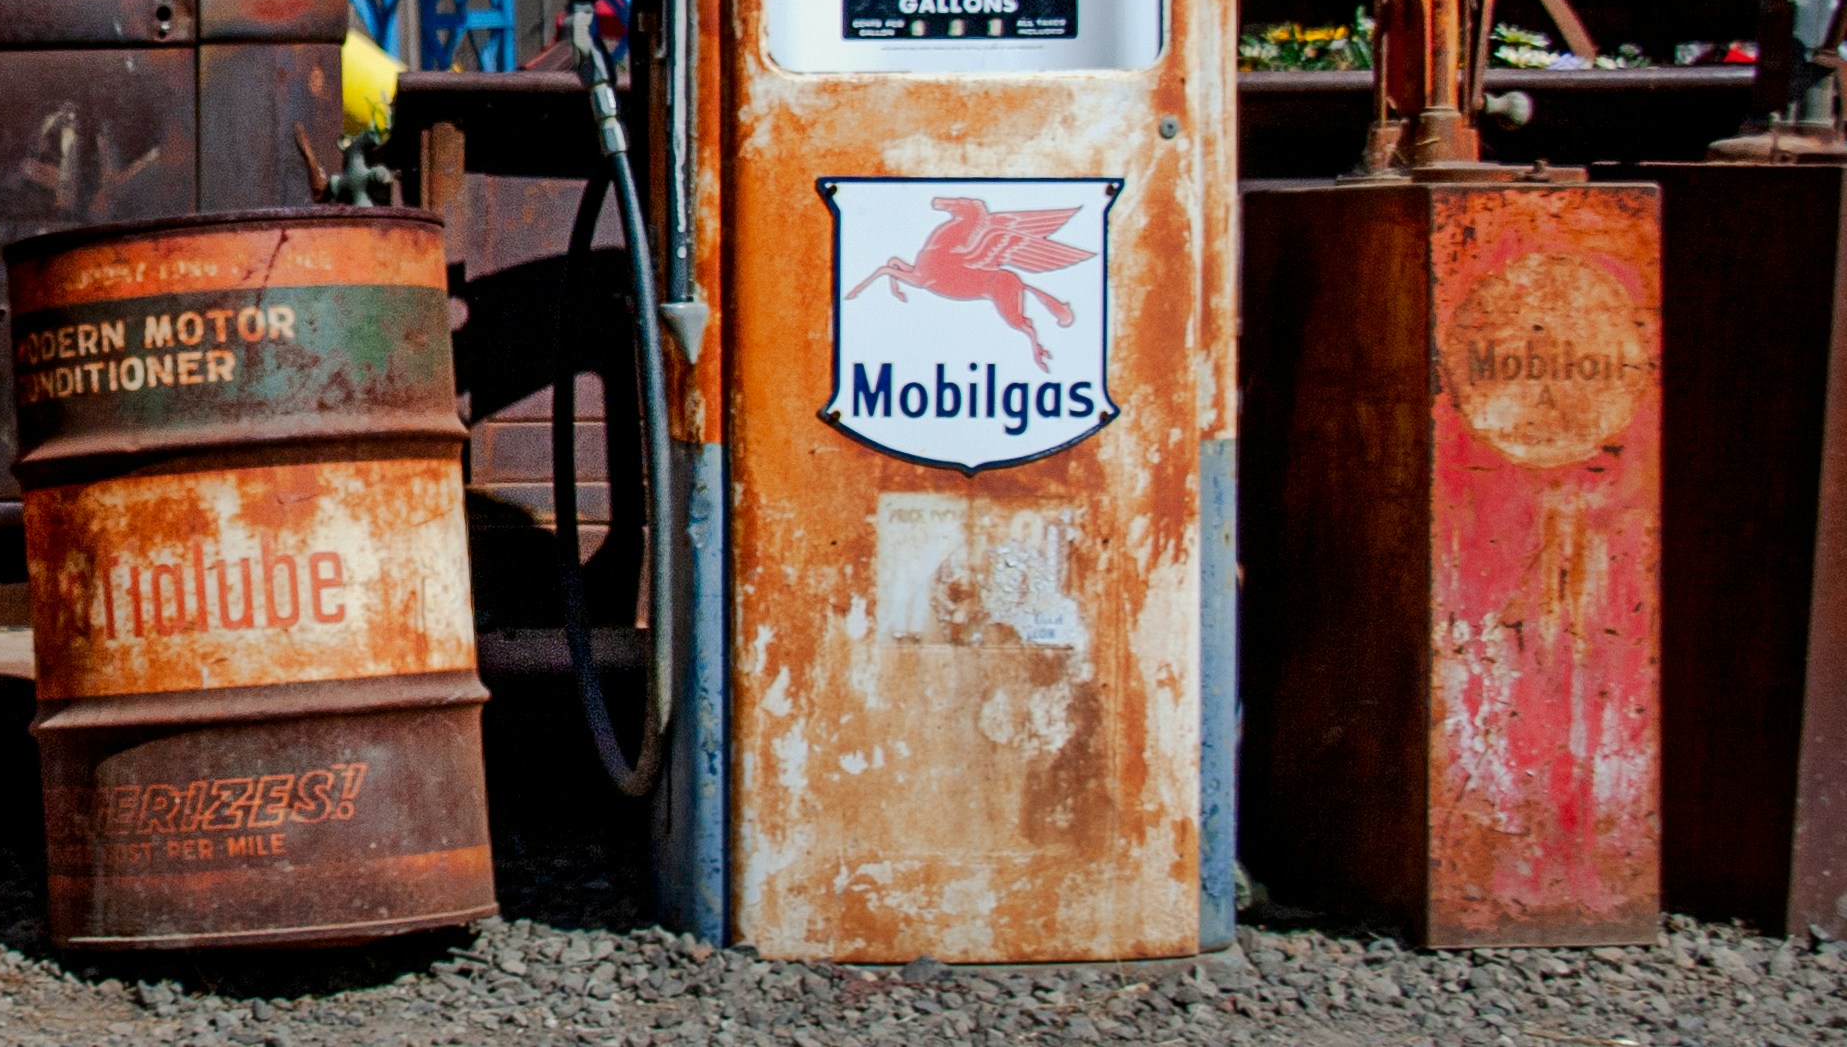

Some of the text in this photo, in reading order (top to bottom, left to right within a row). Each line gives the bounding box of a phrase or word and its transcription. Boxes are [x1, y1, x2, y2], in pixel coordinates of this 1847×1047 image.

[19, 305, 296, 365] ODERN MOTOR
[852, 362, 1095, 436] Mobilgas
[167, 839, 214, 860] PER
[227, 834, 287, 857] MILE
